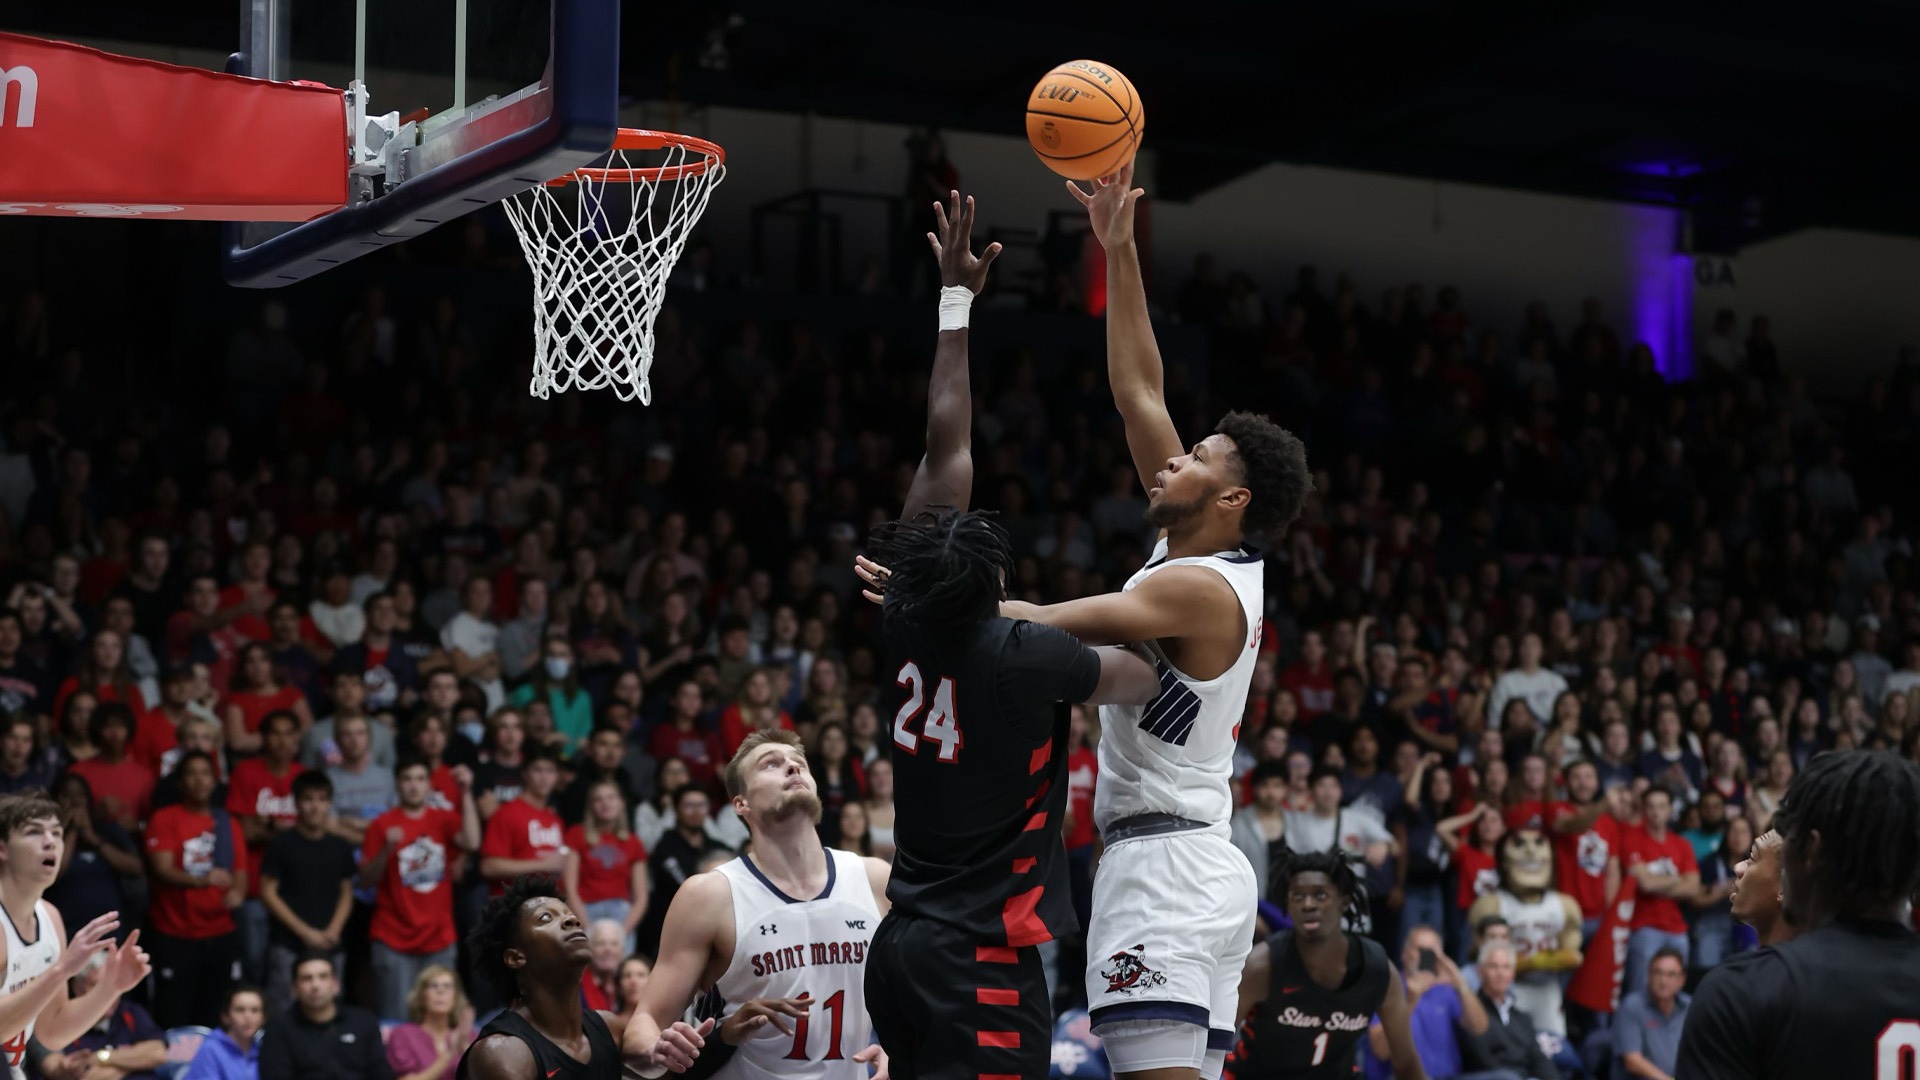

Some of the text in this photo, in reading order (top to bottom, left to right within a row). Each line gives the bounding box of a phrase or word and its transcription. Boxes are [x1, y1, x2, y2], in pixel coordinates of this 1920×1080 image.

[893, 658, 964, 764] 24
[751, 939, 869, 977] SAINT MARY'
[782, 989, 845, 1061] 11
[1278, 1006, 1369, 1032] Stan State
[1311, 1031, 1329, 1067] 1
